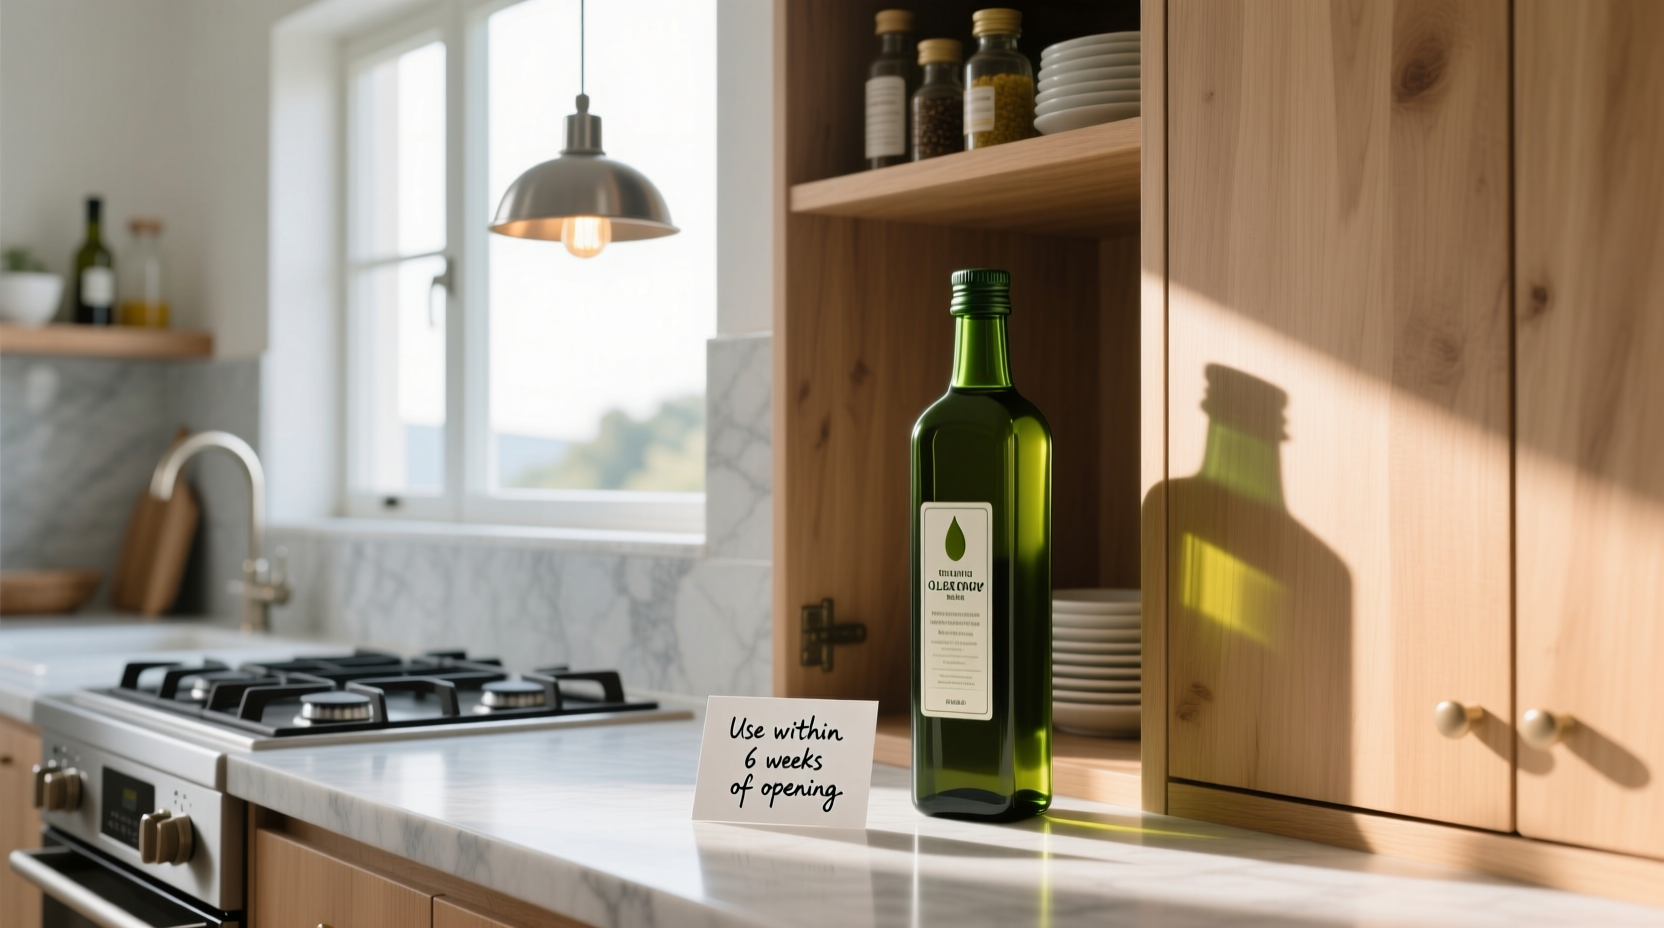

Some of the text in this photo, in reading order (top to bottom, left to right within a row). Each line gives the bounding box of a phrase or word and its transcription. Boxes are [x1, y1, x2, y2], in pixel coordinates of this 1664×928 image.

[730, 715, 844, 741] Use within
[745, 747, 823, 771] 6 weeks
[730, 773, 844, 813] of opening
